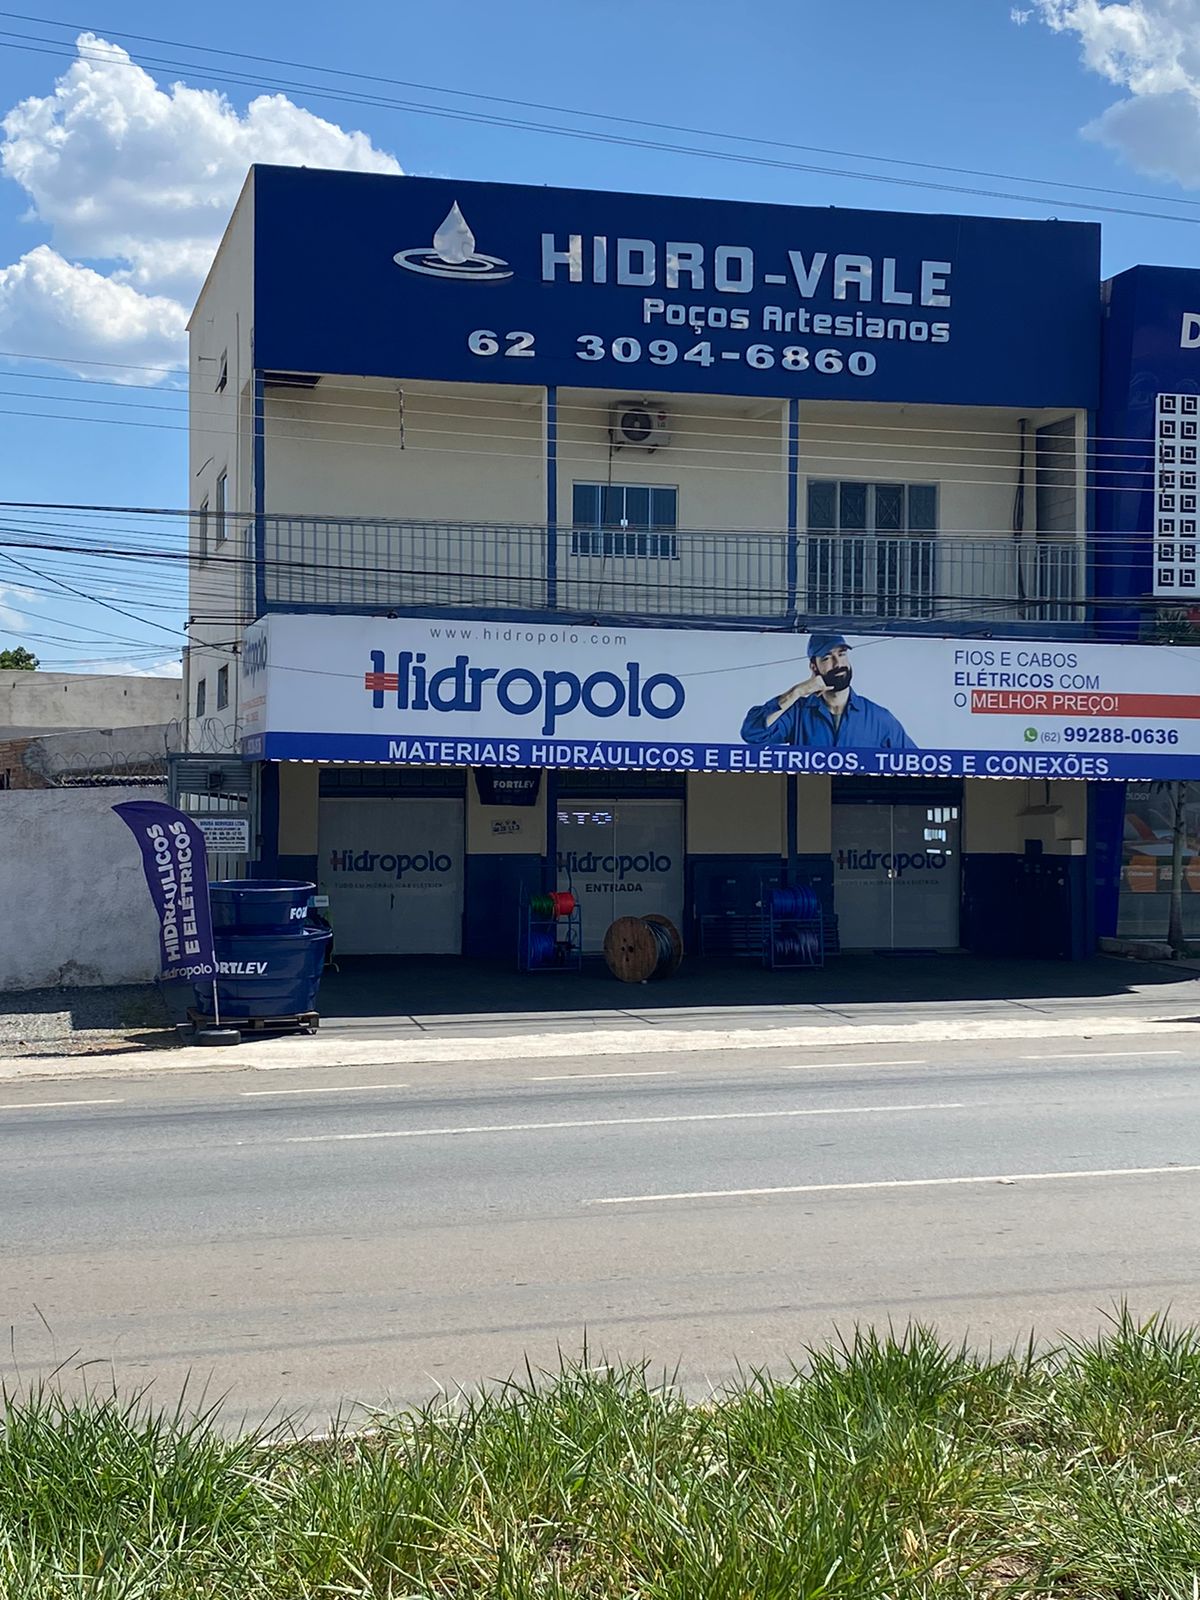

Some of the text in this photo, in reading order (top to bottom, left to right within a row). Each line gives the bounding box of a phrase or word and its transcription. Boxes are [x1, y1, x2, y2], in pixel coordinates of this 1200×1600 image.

[541, 233, 952, 308] HIDRO-VALE
[643, 297, 951, 343] Poços Artesianos
[467, 329, 877, 377] 62 3094-6860
[430, 626, 628, 645] www.hidropolo.com
[954, 650, 1078, 668] FIOS E CABOS
[365, 649, 686, 736] Hidropolo
[954, 669, 1100, 690] ELÉTRICOS COM
[954, 693, 1119, 714] O MELHOR PREÇO!
[1040, 726, 1179, 745] (62) 99288-0636
[388, 740, 1109, 775] MATERIAIS HIDRÁULICOS E ELÉTRICOS. TUBOS E CONEXÕES
[330, 849, 452, 880] Hidropolo
[557, 851, 672, 880] Hidropolo
[837, 849, 947, 877] Hidropolo
[146, 823, 181, 963] HIDRÁULICOS
[168, 820, 201, 955] E ELÉTRICOS
[585, 882, 644, 893] ENTRADA
